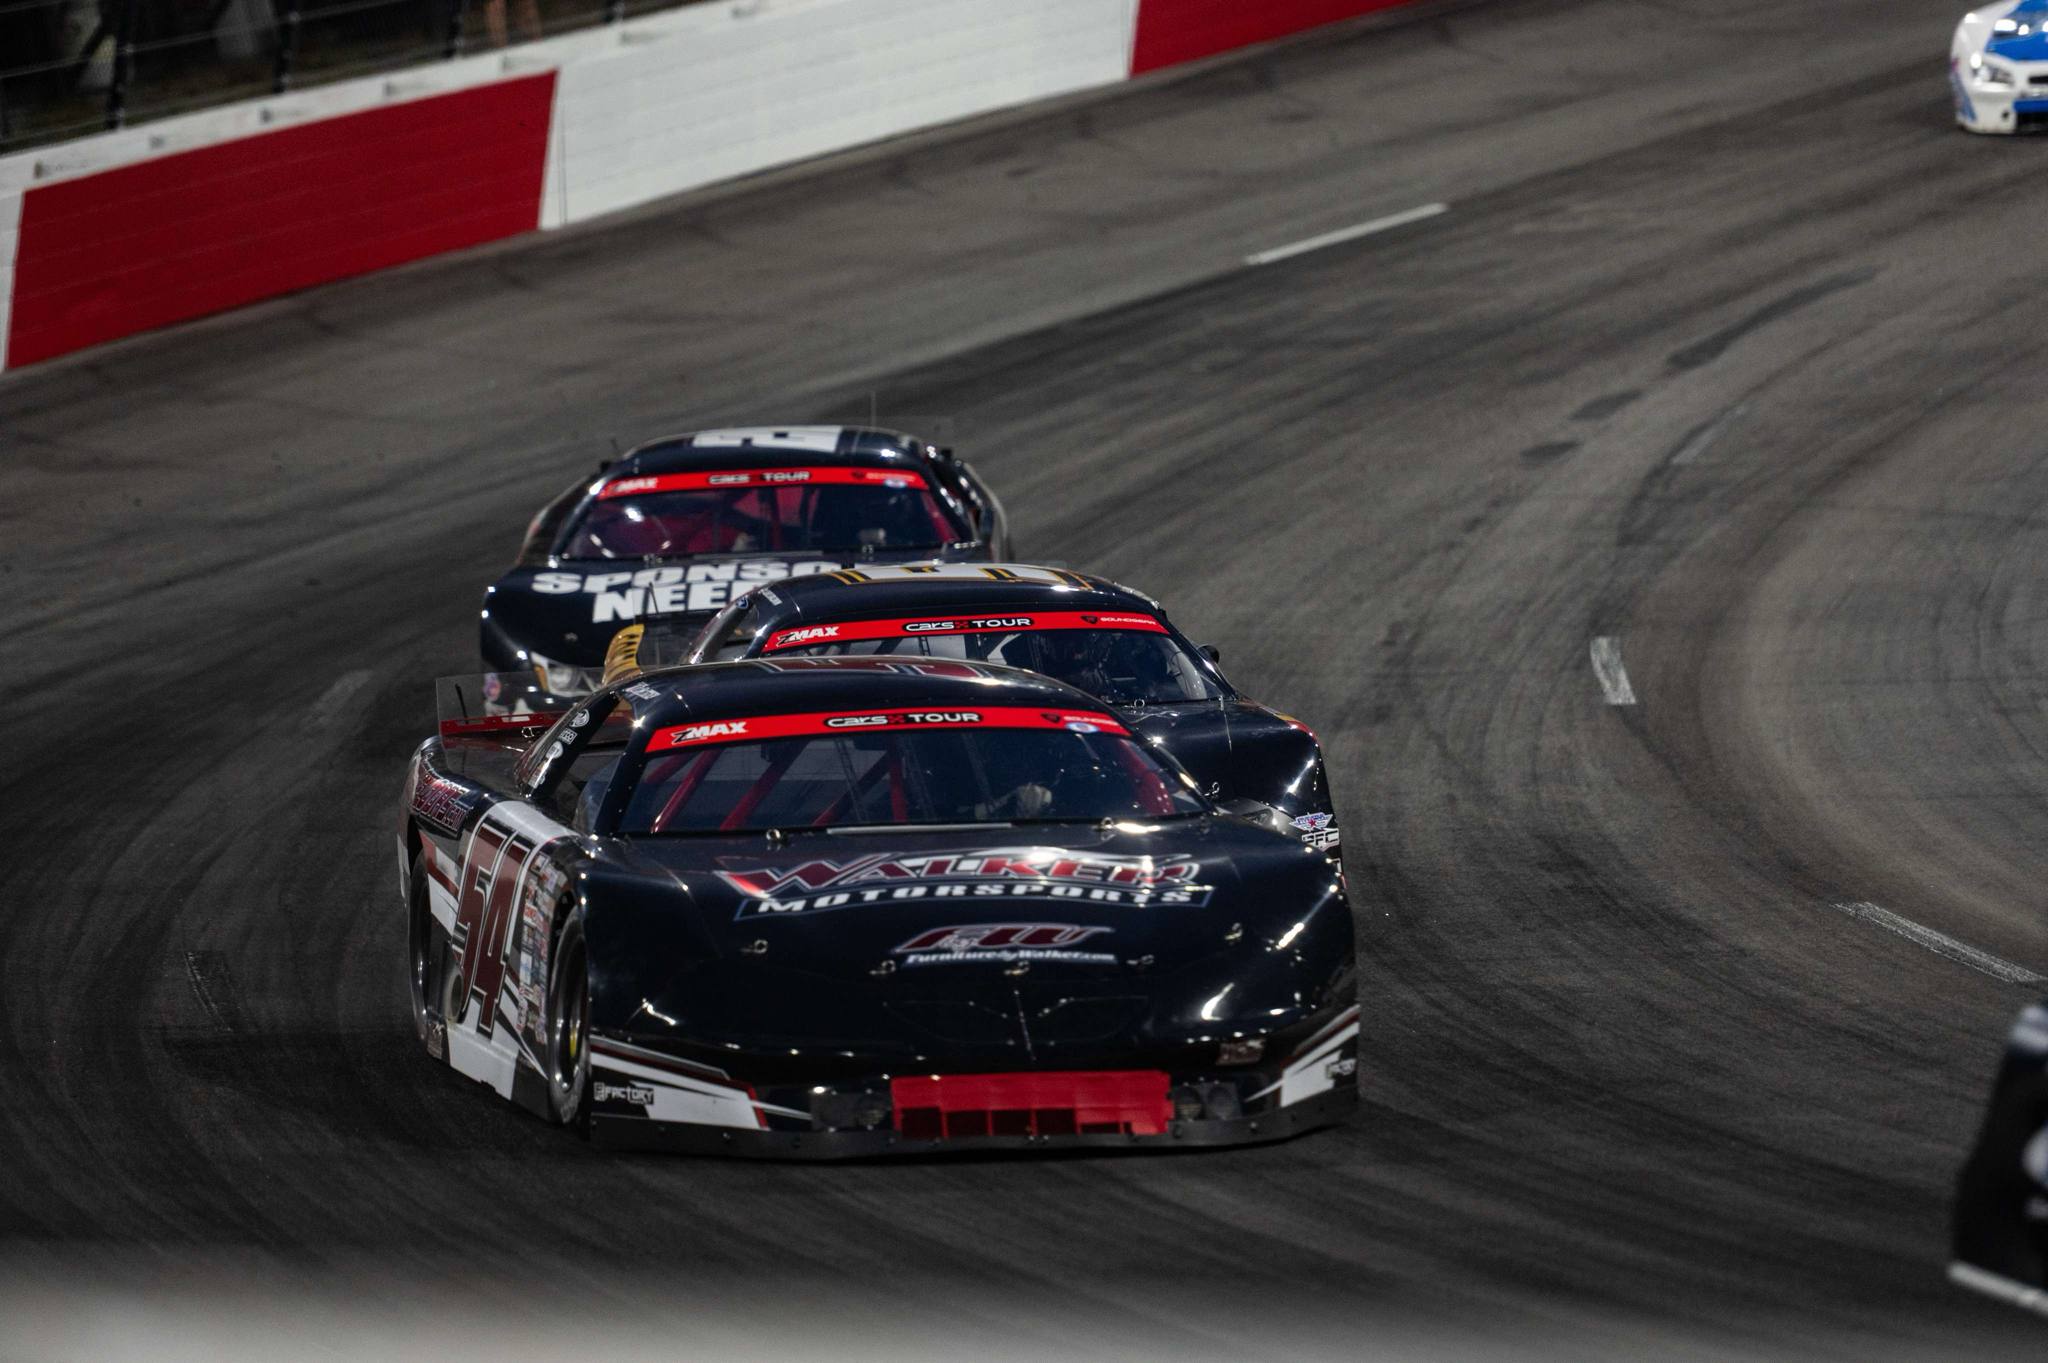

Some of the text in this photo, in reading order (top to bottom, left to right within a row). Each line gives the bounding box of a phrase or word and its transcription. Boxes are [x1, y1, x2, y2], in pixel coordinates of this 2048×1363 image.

[531, 560, 868, 595] SPONSO
[971, 617, 1032, 629] TOUR
[908, 712, 980, 723] TOUR
[757, 883, 1193, 913] MOTORSPORTS
[452, 822, 530, 1033] 54
